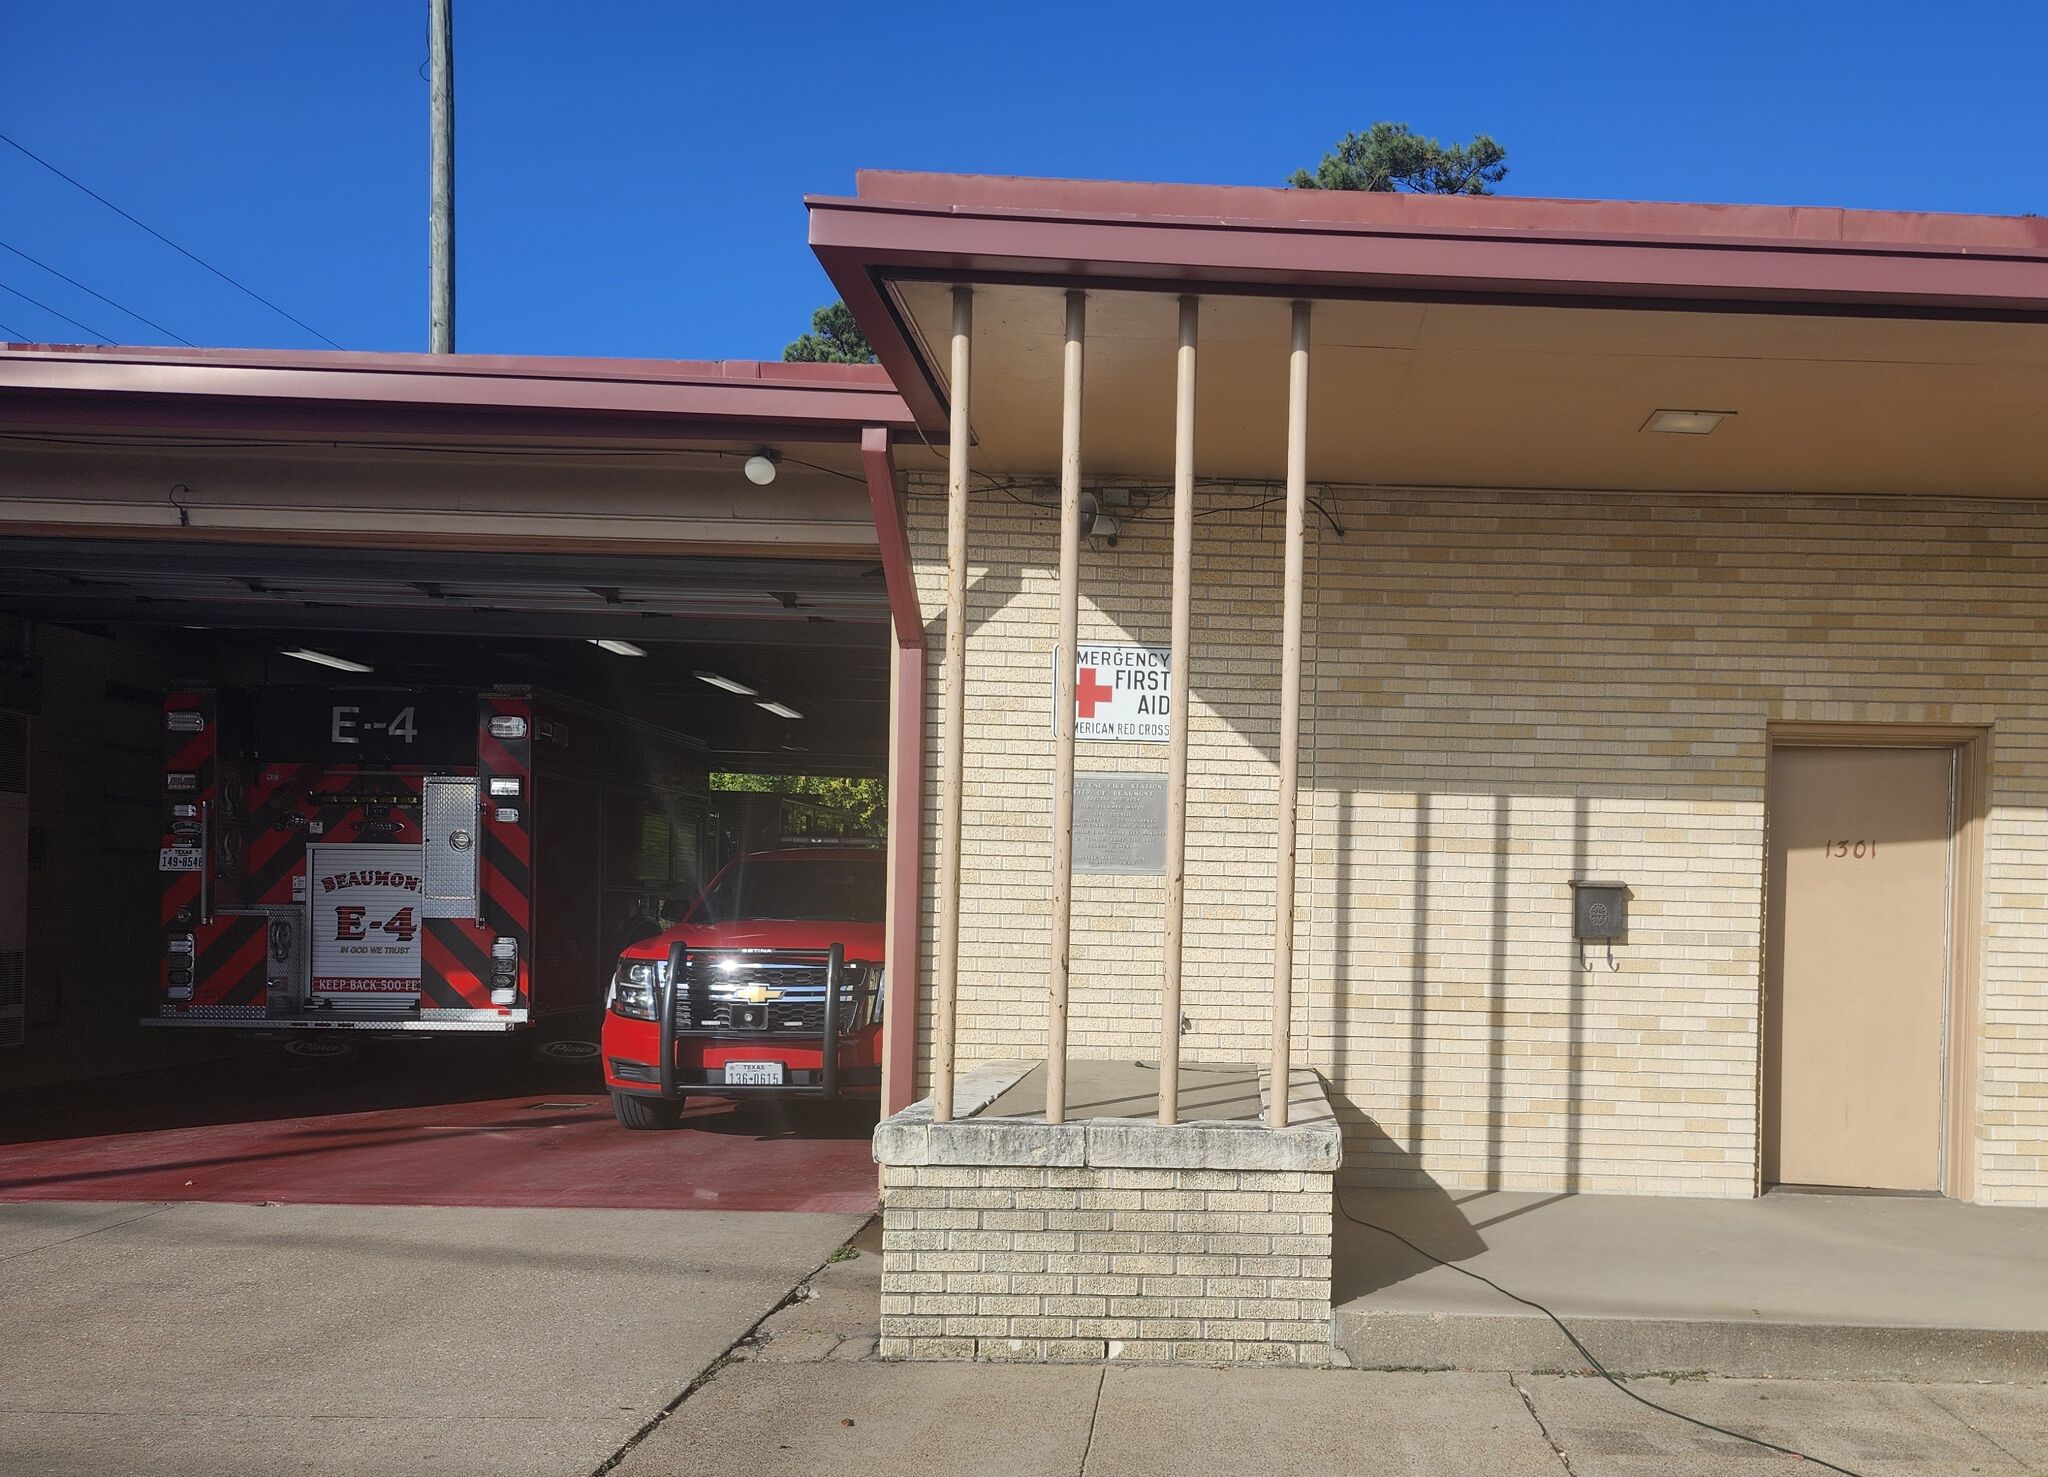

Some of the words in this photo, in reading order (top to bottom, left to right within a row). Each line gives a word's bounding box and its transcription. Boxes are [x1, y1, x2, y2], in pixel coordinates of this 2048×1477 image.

[1077, 651, 1170, 667] MERGENCY
[1115, 669, 1170, 691] FIRST
[1137, 694, 1170, 715] AID
[1075, 722, 1114, 734] MERICAN
[1117, 723, 1136, 735] RED
[1138, 724, 1170, 736] CROSS
[1825, 839, 1877, 860] 1301
[335, 906, 417, 941] E-4
[319, 979, 345, 990] KEEP
[350, 979, 377, 991] BACK
[381, 979, 401, 991] 500
